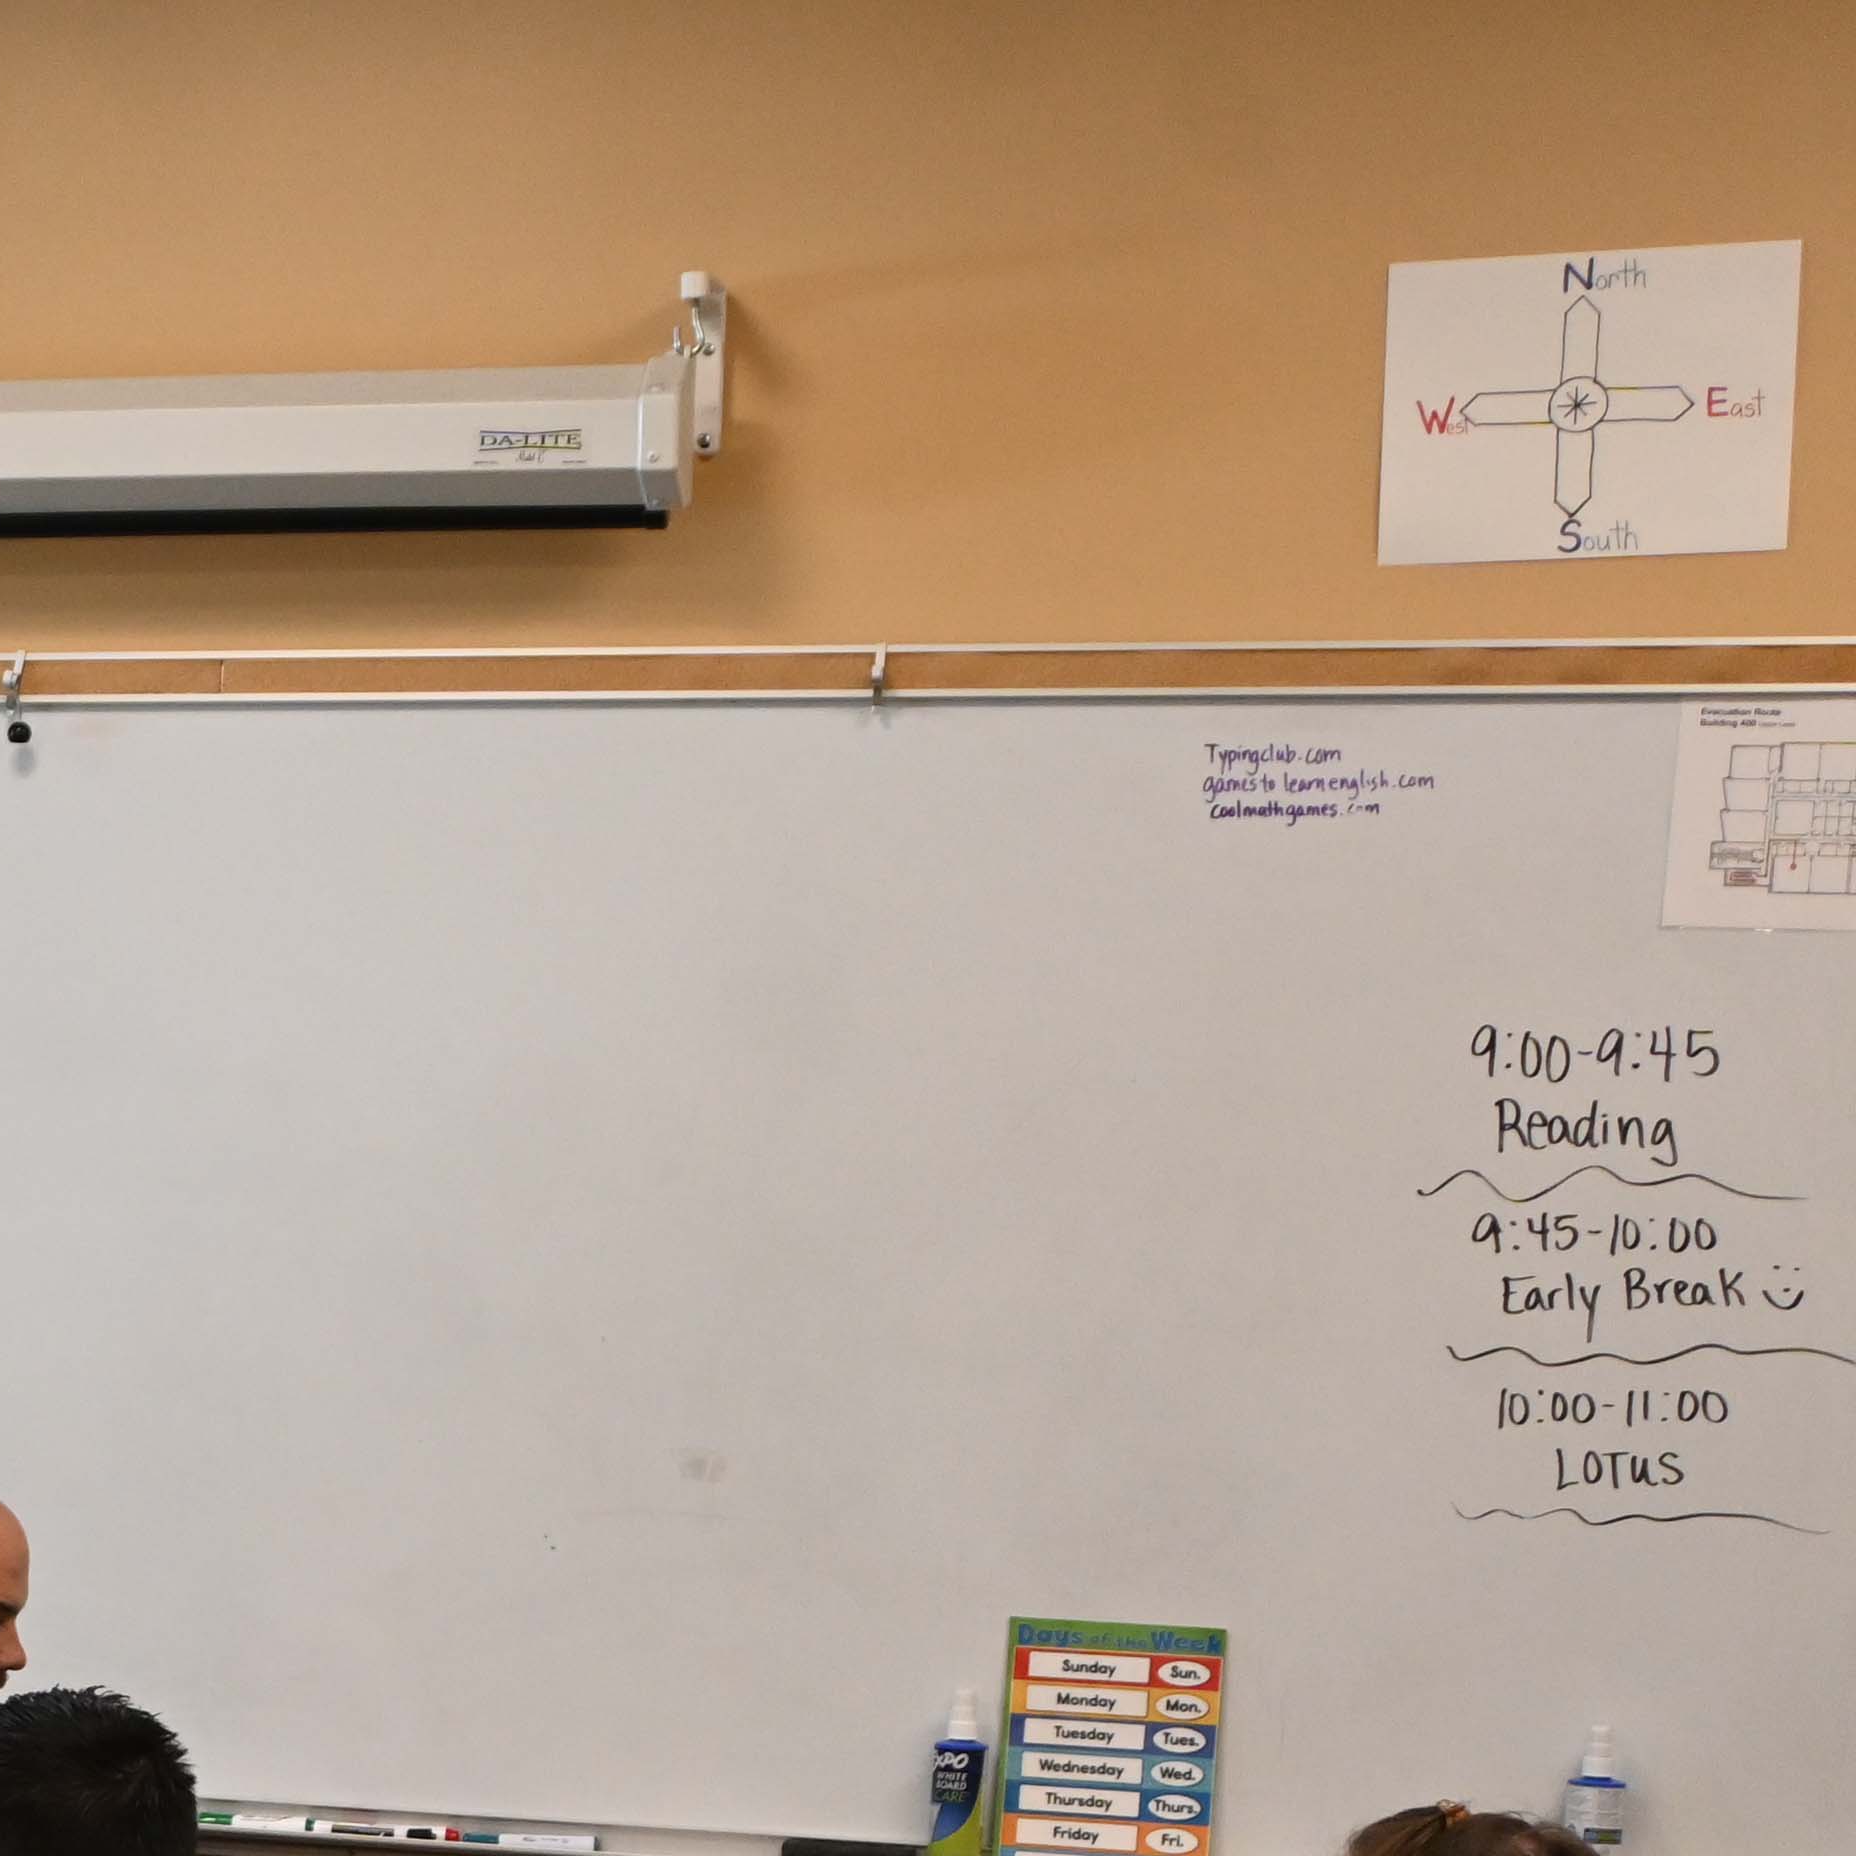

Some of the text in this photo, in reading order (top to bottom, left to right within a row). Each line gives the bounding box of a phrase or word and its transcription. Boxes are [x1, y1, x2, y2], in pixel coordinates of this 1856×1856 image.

[1563, 256, 1647, 293] North
[1416, 395, 1470, 435] West
[1706, 387, 1765, 418] East
[480, 434, 578, 448] DA-LITE
[1557, 518, 1639, 553] South
[1471, 1022, 1722, 1084] 9:00-9:45
[1495, 1097, 1680, 1167] Reading
[1470, 1211, 1719, 1257] 9:45-10:00
[1502, 1268, 1749, 1344] Early Break
[1497, 1387, 1730, 1430] 10:00-11:00
[1017, 1623, 1222, 1653] Days of the Week
[1062, 1659, 1201, 1680] Sunday Sun.
[1056, 1692, 1202, 1714] Monday Mon.
[1054, 1725, 1200, 1747] Tuesday Tues.
[1039, 1758, 1196, 1782] Wednesday Wed.
[1045, 1792, 1198, 1816] Thursday Thurs.
[1052, 1826, 1184, 1848] Friday Fri.
